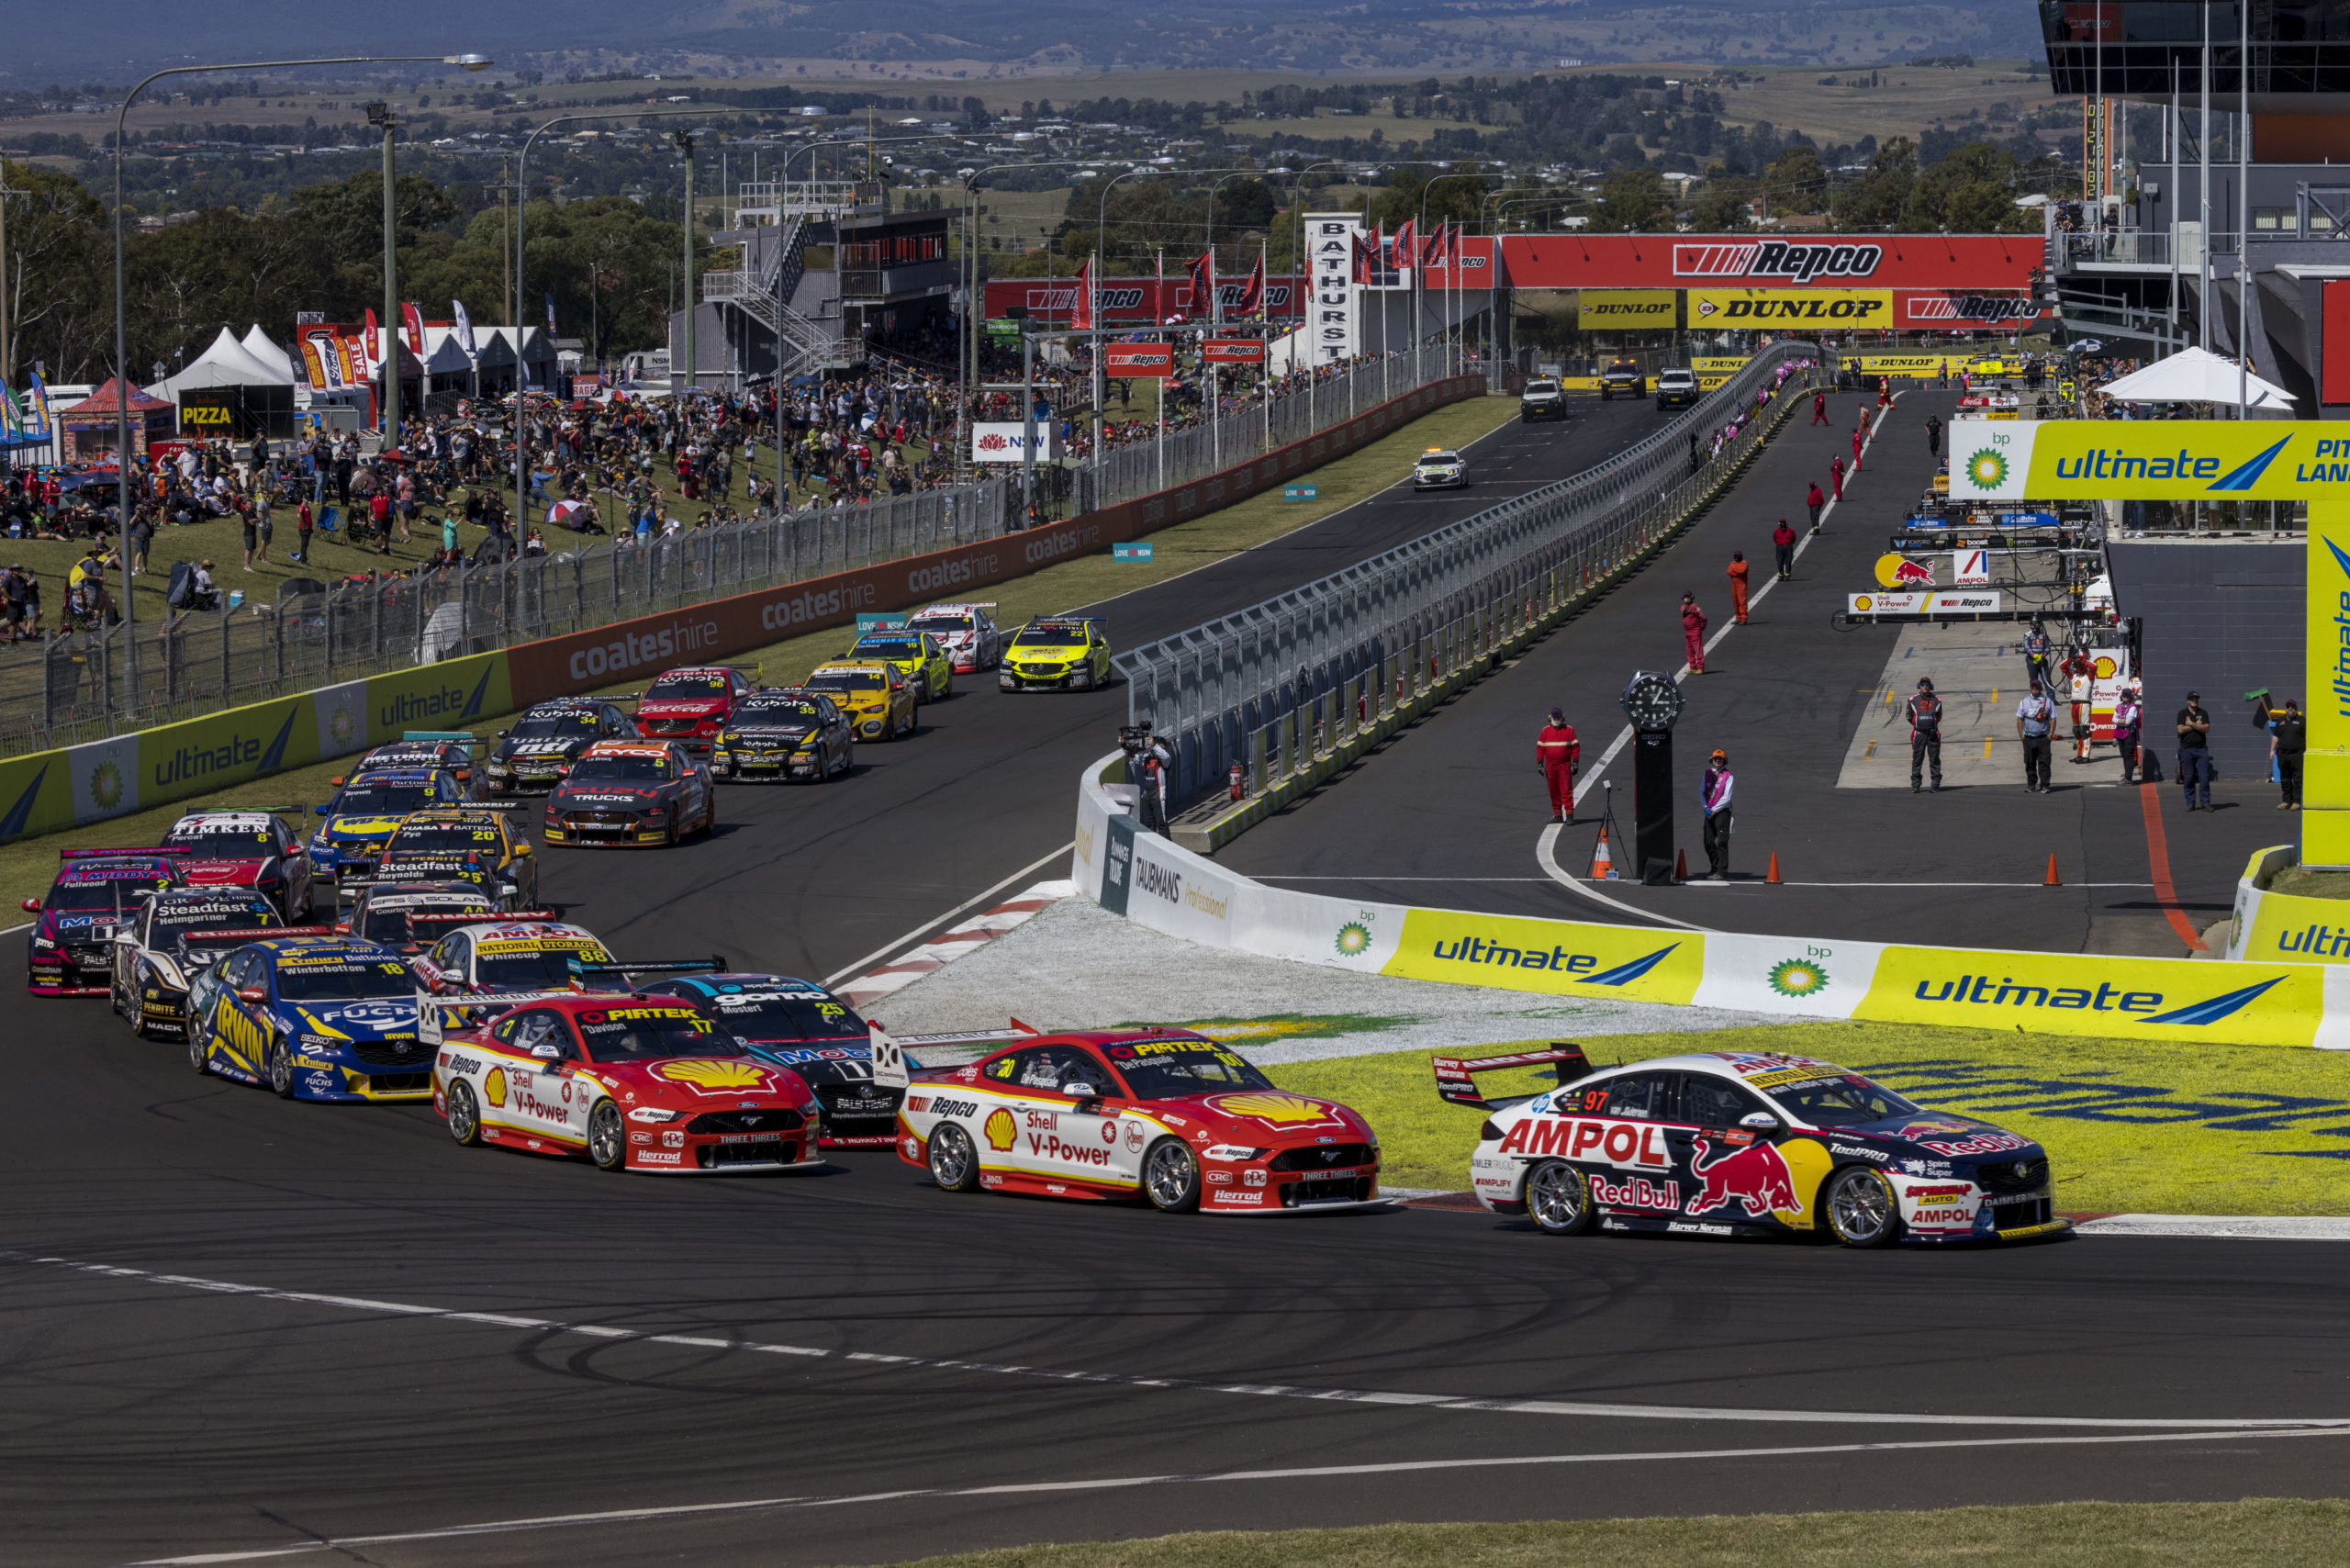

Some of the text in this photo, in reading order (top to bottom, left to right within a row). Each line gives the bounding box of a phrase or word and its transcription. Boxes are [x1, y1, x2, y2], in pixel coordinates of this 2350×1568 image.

[1751, 241, 1882, 283] Repco
[1320, 223, 1347, 358] BATHURST
[1595, 304, 1671, 314] DUNLOP
[1723, 300, 1883, 318] DUNLOP
[1960, 296, 2042, 323] Repco
[1227, 346, 1259, 356] Repco
[327, 348, 340, 380] Ford
[351, 342, 366, 375] SALE
[1132, 354, 1168, 366] Repco
[184, 407, 231, 424] PIZZA
[1993, 431, 2010, 447] bp
[2055, 449, 2221, 479] ultimate
[1115, 549, 1151, 557] LOVE NSW
[1961, 598, 1993, 608] Repco
[859, 622, 904, 631] LOVE NSW
[657, 675, 726, 683] Kubota
[709, 680, 724, 689] 96
[381, 685, 463, 727] ultimate
[638, 703, 717, 714] Coca-Cola
[746, 700, 812, 708] Kubota
[799, 706, 816, 714] 35
[529, 710, 595, 718] Kubota
[579, 716, 597, 724] 34
[516, 741, 576, 754] nti
[591, 748, 666, 756] RYCO
[155, 735, 262, 786] ultimate
[364, 754, 441, 762] METHOD
[655, 758, 665, 767] 5
[424, 788, 435, 797] 9
[557, 786, 658, 799] ISUZU
[574, 794, 635, 802] TRUCKS
[173, 824, 267, 835] TIMKEN
[173, 834, 203, 842] Percat
[258, 833, 267, 843] 8
[472, 831, 496, 841] 20
[379, 861, 462, 873] Steadfast
[1109, 859, 1122, 887] TRADE
[86, 871, 170, 880] MIDDY'S
[378, 871, 425, 881] Reynolds
[64, 879, 106, 889] Fullwood
[157, 879, 169, 889] 2
[1136, 856, 1228, 921] TAUBMANS Professional
[370, 895, 487, 905] EFS SOLAR
[158, 902, 248, 917] Steadfast
[375, 905, 414, 915] Courtney
[1360, 910, 1375, 921] bp
[160, 914, 228, 925] Heimgartner
[255, 913, 268, 925] 7
[481, 928, 589, 941] AMPOL
[35, 937, 54, 949] gomo
[478, 940, 597, 955] NATIONAL STORAGE
[482, 951, 541, 962] Whincup
[578, 950, 609, 962] 88
[1433, 936, 1598, 974] ultimate
[1807, 945, 1832, 958] bp
[291, 954, 399, 965] Century Batteries
[285, 964, 366, 976] Winterbottom
[377, 963, 405, 975] 18
[459, 991, 543, 1002] AUTHENTIC
[714, 991, 829, 1006] gomo
[1915, 975, 2164, 1013] ultimate
[144, 1002, 175, 1016] PENRITE
[323, 1005, 419, 1023] FUCH
[608, 1007, 700, 1021] PIRTEK
[721, 1003, 763, 1015] Mostert
[814, 1002, 845, 1016] 25
[146, 1021, 183, 1032] MACK
[217, 993, 264, 1071] IRWIN
[587, 1022, 627, 1035] Davison
[688, 1019, 713, 1034] 17
[300, 1034, 330, 1045] SEIKO
[384, 1032, 415, 1040] IRWIN
[1133, 1041, 1223, 1056] PIRTEK
[297, 1055, 334, 1070] Century
[449, 1053, 482, 1075] Repco
[1214, 1052, 1245, 1068] 100
[1433, 1058, 1460, 1070] Harvey
[1731, 1056, 1821, 1075] AMPOL
[512, 1069, 533, 1090] Shell
[1437, 1069, 1466, 1080] Norman
[1751, 1069, 1806, 1087] NATIONAL
[305, 1075, 333, 1088] FUCHS
[1438, 1081, 1473, 1092] ToolPRO
[1767, 1081, 1789, 1095] van
[930, 1095, 979, 1119] Repco
[1584, 1091, 1608, 1111] 97
[513, 1090, 569, 1125] V-Power
[646, 1111, 672, 1121] Repco
[1027, 1111, 1058, 1131] Shell
[632, 1134, 652, 1143] CRC
[663, 1131, 684, 1146] PPG
[720, 1133, 780, 1144] THREE THREES
[1498, 1118, 1665, 1166] AMPOL
[638, 1149, 681, 1162] Herrod
[1027, 1132, 1113, 1167] V-Power
[1225, 1148, 1252, 1158] Repco
[1830, 1142, 1889, 1162] ToolPRO
[1926, 1159, 1951, 1170] Spirit
[1209, 1172, 1230, 1182] CRC
[1245, 1170, 1266, 1184] PPG
[1302, 1169, 1357, 1181] THREE THREES
[1926, 1168, 1953, 1179] Super
[1479, 1178, 1512, 1188] AMPLIFY
[1214, 1190, 1263, 1202] Herrod
[1905, 1182, 1972, 1199] SUPERCHEAP
[1923, 1195, 1953, 1204] AUTO
[1910, 1209, 1974, 1224] AMPOL
[1698, 1223, 1732, 1236] Norman
